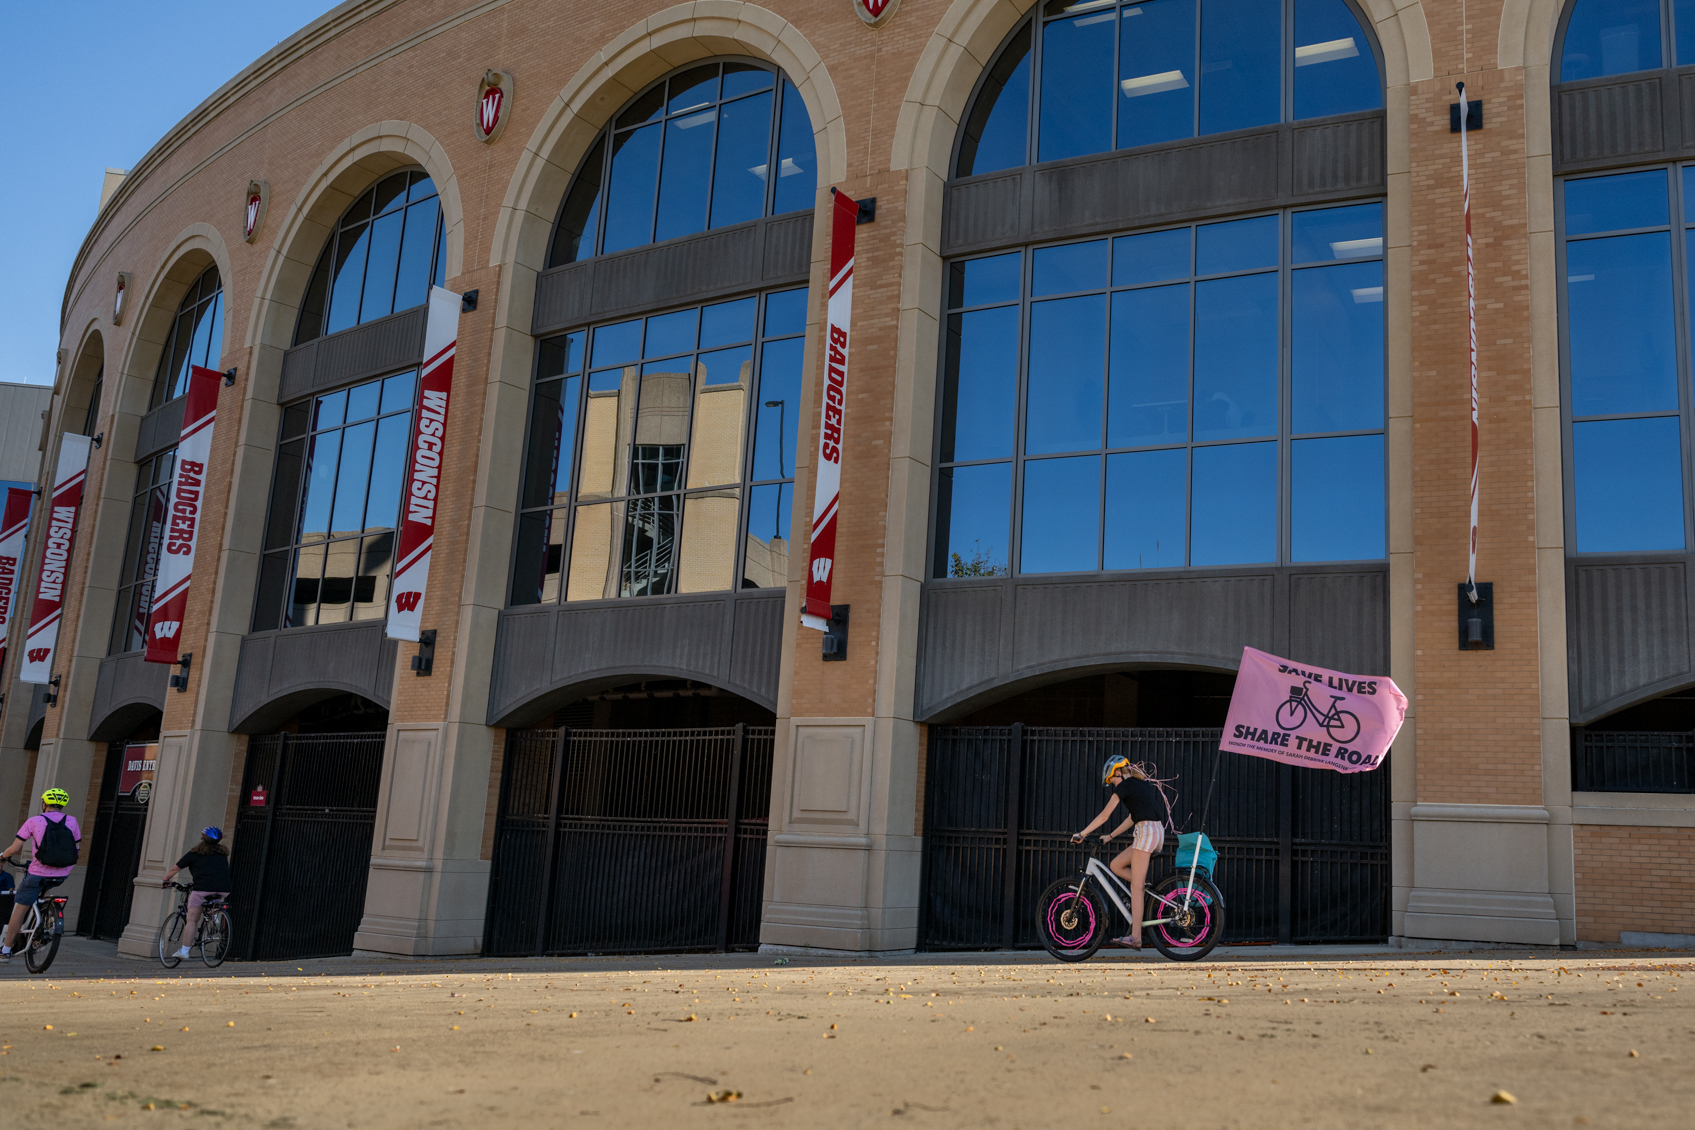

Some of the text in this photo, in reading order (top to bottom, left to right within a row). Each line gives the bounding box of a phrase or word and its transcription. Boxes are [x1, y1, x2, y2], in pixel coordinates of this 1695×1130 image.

[482, 93, 501, 130] W
[822, 323, 848, 465] BADGERS
[408, 388, 448, 527] WISCONSIN
[166, 458, 204, 557] BADGERS
[38, 505, 76, 602] WISCONSIN
[811, 557, 832, 585] W
[395, 590, 422, 614] W
[153, 620, 181, 640] W
[27, 647, 51, 664] W
[1328, 676, 1378, 695] LIVES
[1233, 724, 1291, 748] SHARE
[1295, 735, 1334, 757] THE
[1256, 746, 1278, 754] MEMORY
[1285, 752, 1304, 760] SARAH
